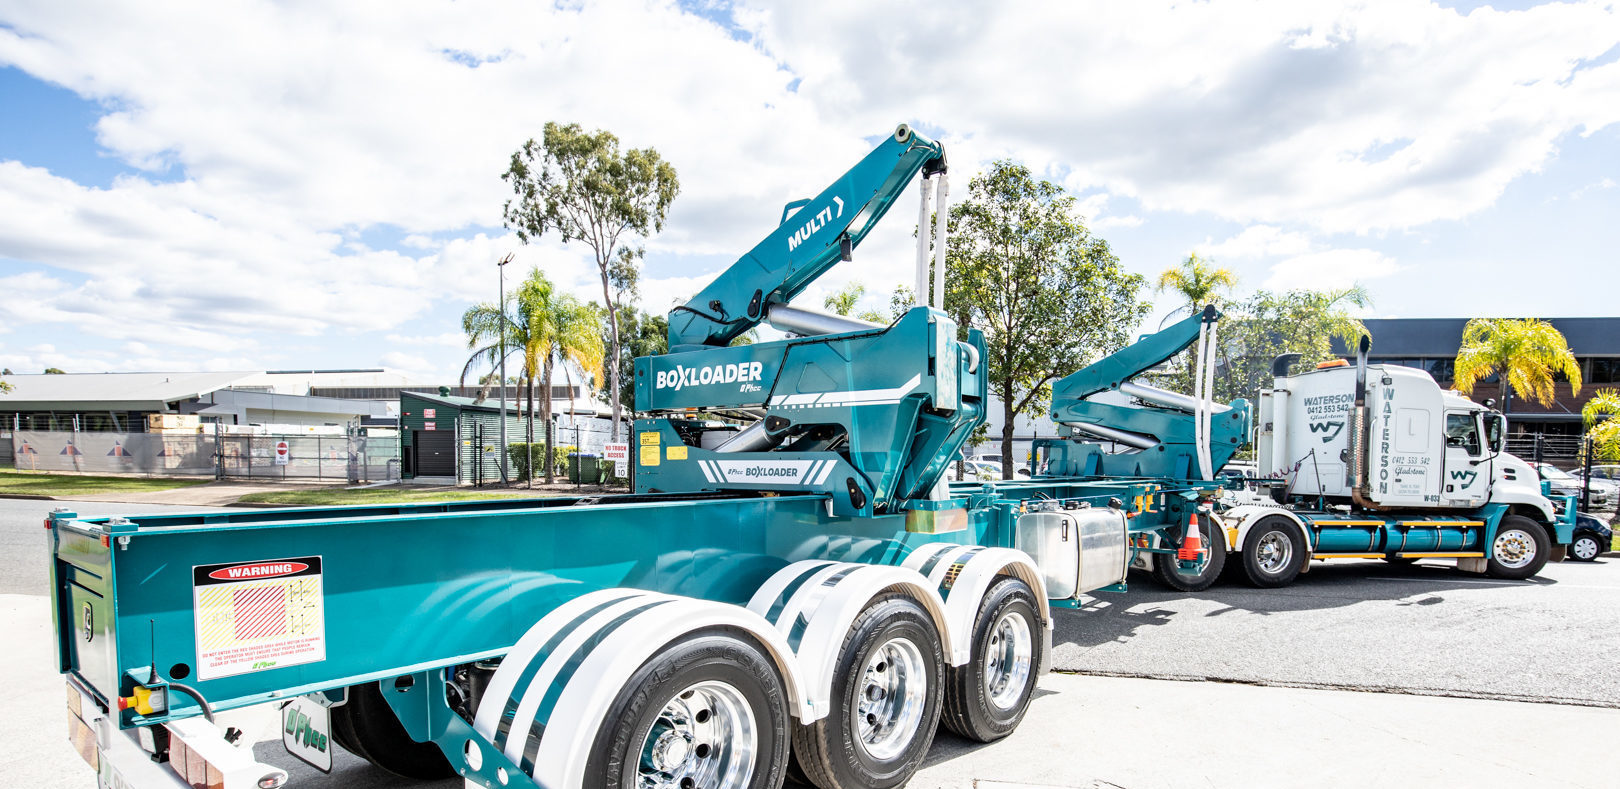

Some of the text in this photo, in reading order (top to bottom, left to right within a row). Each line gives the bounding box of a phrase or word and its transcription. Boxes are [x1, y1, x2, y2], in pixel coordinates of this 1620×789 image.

[788, 206, 832, 252] MULTI
[656, 361, 763, 391] BOXLOADER
[1303, 393, 1355, 406] WATERSON
[1307, 404, 1349, 414] 0412 553 542
[1380, 388, 1395, 494] WATERSON
[1392, 456, 1430, 465] 0412 553 542
[745, 465, 798, 478] BOXLOADER
[1394, 467, 1426, 476] Gladstone
[228, 564, 292, 578] WARNING
